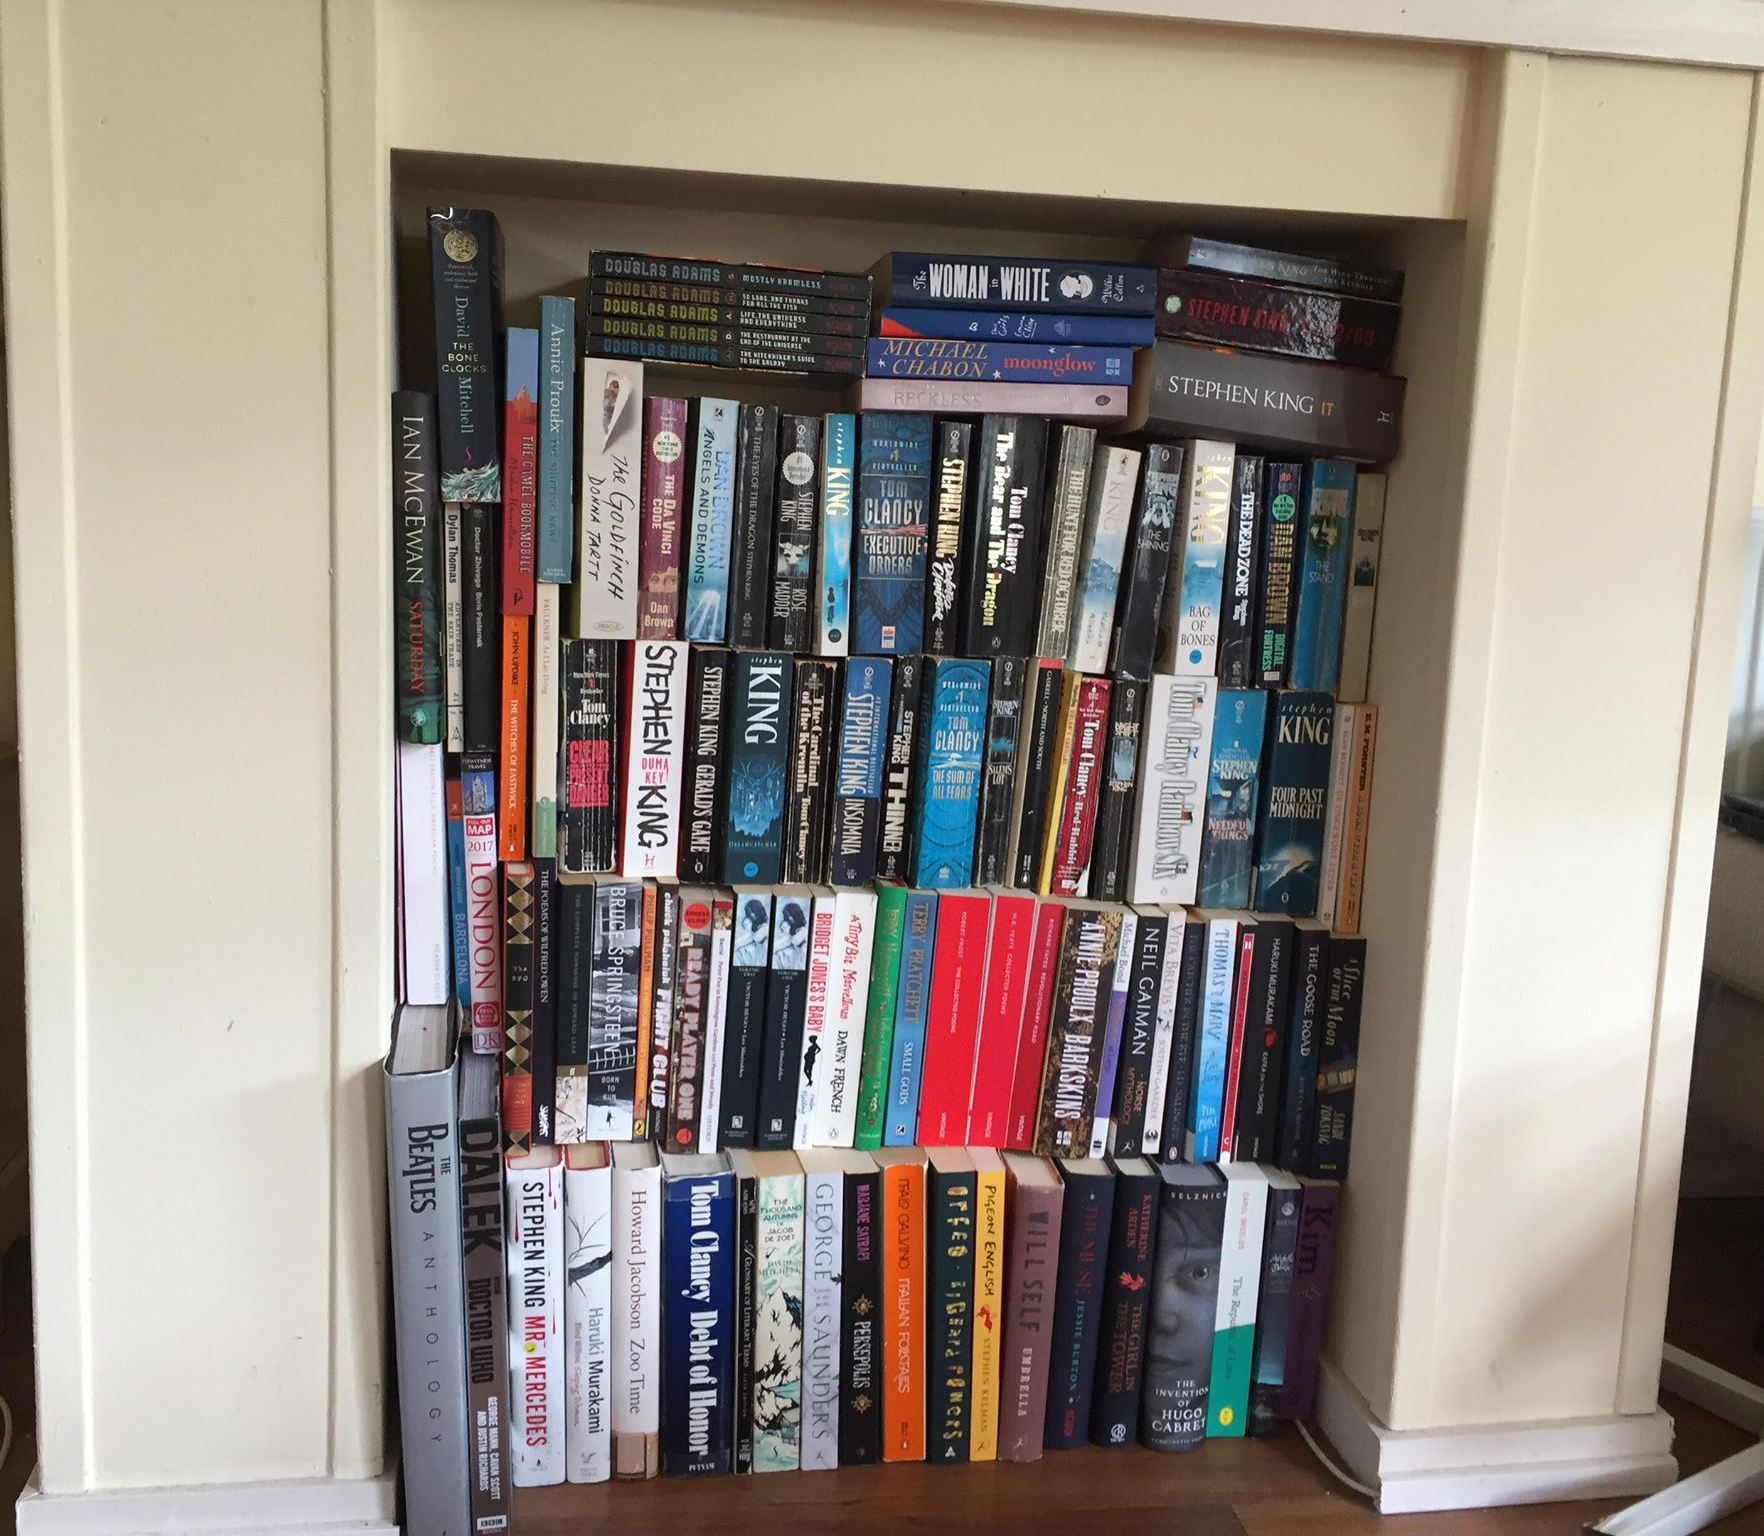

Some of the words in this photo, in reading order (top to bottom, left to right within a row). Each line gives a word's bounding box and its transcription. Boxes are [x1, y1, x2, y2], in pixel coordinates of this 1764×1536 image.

[605, 258, 666, 281] DOUGLAS
[672, 264, 720, 282] ADAMS
[742, 274, 774, 284] MOSTLY
[777, 277, 821, 289] HARMLESS
[913, 270, 927, 291] The
[929, 264, 988, 299] WOMAN
[989, 278, 998, 288] in
[1000, 267, 1050, 302] WHITE
[455, 296, 469, 338] David
[603, 298, 664, 317] DOUGLAS
[670, 303, 718, 322] ADAMS
[452, 342, 473, 350] THE
[550, 323, 564, 372] Annie
[603, 320, 664, 338] DOUGLAS
[670, 324, 717, 343] ADAMS
[883, 340, 989, 359] MICHAEL
[442, 364, 486, 373] CLOCKS
[448, 353, 479, 362] BONE
[892, 359, 989, 378] CHABON
[1003, 353, 1095, 376] moonglow
[459, 377, 473, 433] Mitchell
[550, 376, 564, 432] Proulx
[1168, 375, 1258, 405] STEPHEN
[1264, 390, 1313, 414] KING
[1321, 402, 1334, 416] IT
[701, 428, 715, 483] ANGELS
[835, 422, 844, 464] stephen
[698, 489, 708, 518] AND
[826, 466, 851, 515] KING
[939, 458, 965, 522] STEPHEN
[1009, 487, 1028, 518] Tom
[1191, 465, 1231, 544] KING
[1241, 492, 1255, 519] THE
[447, 514, 459, 542] Dylan
[780, 500, 797, 522] KING
[797, 491, 813, 530] STEPHEN
[864, 497, 922, 525] CLANCY
[474, 527, 482, 553] Doctor
[694, 524, 707, 584] DEMONS
[935, 523, 960, 558] KING
[1001, 523, 1025, 574] Clancy
[1238, 521, 1253, 558] DEAD
[448, 545, 459, 584] Thomas
[474, 556, 482, 588] Zhivago
[1235, 558, 1249, 596] ZONE
[476, 612, 484, 647] Pasternak
[1189, 606, 1212, 617] BAG
[1191, 620, 1206, 632] OF
[408, 601, 424, 691] SATURDAY
[1180, 634, 1216, 646] BONES
[1261, 629, 1273, 671] FORTRESS
[1273, 633, 1286, 667] DIGITAL
[642, 645, 678, 755] STEPHEN
[700, 666, 722, 720] STEPHEN
[1043, 670, 1052, 700] GASKELL
[745, 666, 782, 745] KING
[844, 693, 874, 754] STEPHEN
[1040, 705, 1049, 730] NORTH
[698, 724, 718, 755] KING
[892, 735, 902, 764] KING
[901, 711, 914, 764] STEPHEN
[935, 731, 979, 752] CLANCY
[1278, 716, 1330, 744] KING
[840, 758, 868, 795] KING
[1035, 746, 1043, 770] SOUTH
[693, 764, 715, 816] GERALD'S
[883, 766, 908, 852] THINNER
[1272, 787, 1296, 802] FOUR
[1299, 789, 1324, 804] PAST
[468, 825, 492, 835] MAP
[637, 785, 669, 848] KING
[840, 798, 865, 855] INSOMNIA
[1269, 802, 1323, 819] MIDNIGHT
[468, 841, 493, 851] 2017
[690, 820, 711, 853] GAME
[470, 861, 496, 990] LONDON
[609, 887, 626, 938] BRUCE
[455, 913, 467, 984] BARCELONA
[844, 923, 861, 947] Tiny
[1045, 919, 1054, 948] RICHARD
[1076, 921, 1106, 965] ANNIE
[1142, 927, 1160, 970] NEIL
[844, 948, 859, 964] Bit
[1270, 938, 1281, 973] HARUKI
[1308, 945, 1319, 971] THE
[685, 947, 703, 1008] READY
[840, 969, 857, 1020] Marvellous
[1068, 969, 1099, 1022] PROULX
[1303, 974, 1317, 1017] GOOSE
[604, 946, 624, 1052] SPRINGSTEEN
[1034, 972, 1046, 1023] REVOLUTIONARY
[1131, 977, 1154, 1055] GAIMAN
[1265, 975, 1278, 1024] MURAKAMI
[680, 1012, 700, 1080] PLAYER
[835, 1030, 848, 1064] DAWN
[1300, 1019, 1313, 1056] ROAD
[831, 1068, 845, 1113] FRENCH
[1054, 1034, 1092, 1119] BARKSKINS
[677, 1082, 693, 1120] ONE
[402, 1122, 450, 1214] BEATLES
[440, 1156, 452, 1175] THE
[460, 1117, 501, 1257] DALEK
[690, 1181, 719, 1227] Tom
[898, 1178, 910, 1209] ITALO
[523, 1182, 545, 1262] STEPHEN
[630, 1190, 647, 1255] Howard
[814, 1184, 833, 1281] GEORGE
[1024, 1211, 1049, 1269] WILL
[1126, 1208, 1138, 1247] ARDEN
[898, 1216, 910, 1270] CALVINO
[681, 1231, 719, 1303] Clancy
[743, 1257, 753, 1296] GLOSSARY
[524, 1267, 546, 1308] KING
[627, 1259, 646, 1329] Jacobson
[744, 1297, 752, 1306] OF
[898, 1278, 910, 1327] ITALIAN
[1019, 1280, 1042, 1332] SELF
[422, 1231, 443, 1443] ANTHOLOGY
[588, 1307, 604, 1356] Haruki
[688, 1310, 718, 1364] Debt
[743, 1307, 752, 1343] LITERARY
[1074, 1299, 1086, 1338] JESSIE
[630, 1339, 645, 1372] Zoo
[894, 1332, 910, 1393] FOLKTALES
[1069, 1343, 1081, 1390] BURTON
[629, 1374, 645, 1414] Time
[689, 1367, 717, 1385] of
[811, 1314, 832, 1440] SAUNDERS
[1018, 1348, 1032, 1416] UMBRELLA
[488, 1396, 498, 1424] GEORGE
[525, 1357, 546, 1446] MERCEDES
[588, 1361, 604, 1434] Murakami
[1162, 1408, 1202, 1420] HUGO
[477, 1410, 486, 1426] AND
[689, 1390, 716, 1455] Honor
[477, 1427, 488, 1452] JUSTIN
[488, 1427, 500, 1451] MANN,
[478, 1454, 489, 1492] RICHARDS
[489, 1453, 500, 1477] CAVAN
[489, 1478, 501, 1500] SCOTT
